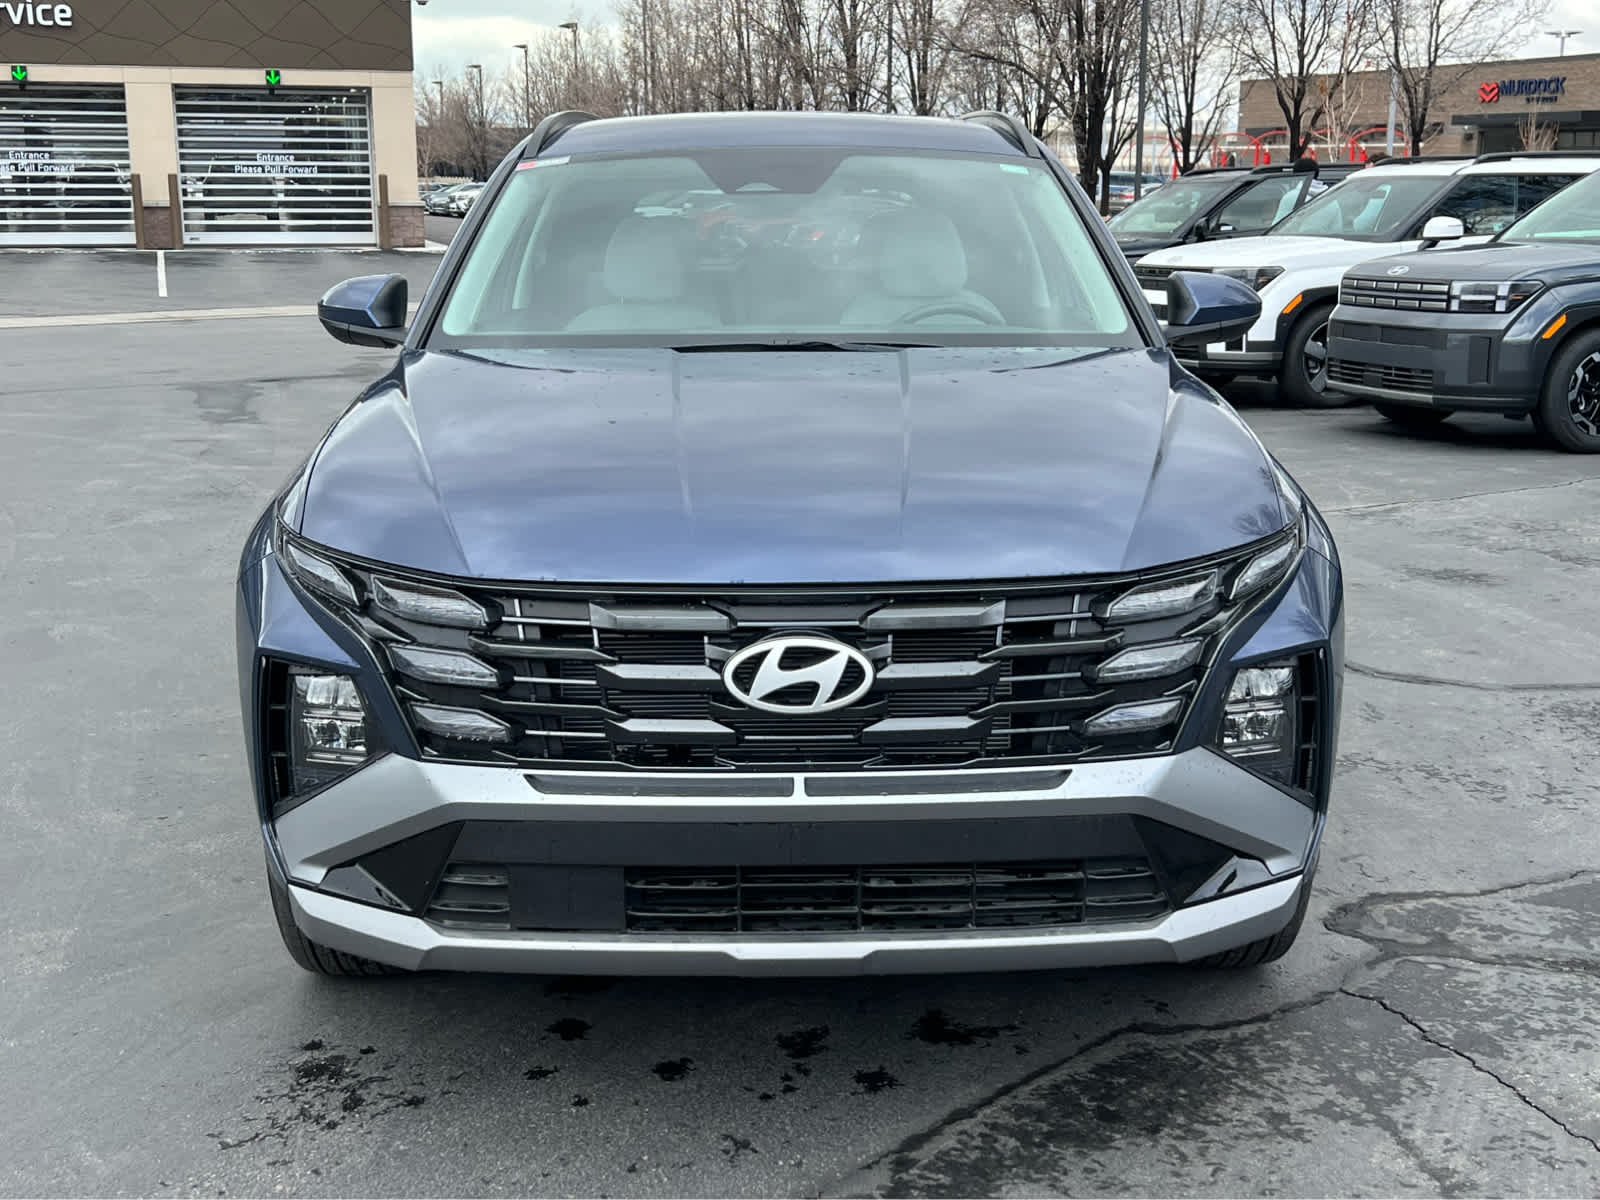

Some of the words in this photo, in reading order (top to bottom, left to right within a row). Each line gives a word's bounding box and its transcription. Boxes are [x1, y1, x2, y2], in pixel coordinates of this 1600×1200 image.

[8, 151, 50, 161] Entrance
[256, 152, 295, 162] Entrance
[18, 162, 36, 173] Pull
[38, 163, 75, 173] Forward
[234, 164, 262, 174] Please
[265, 164, 281, 174] Pull
[283, 164, 318, 174] Forward
